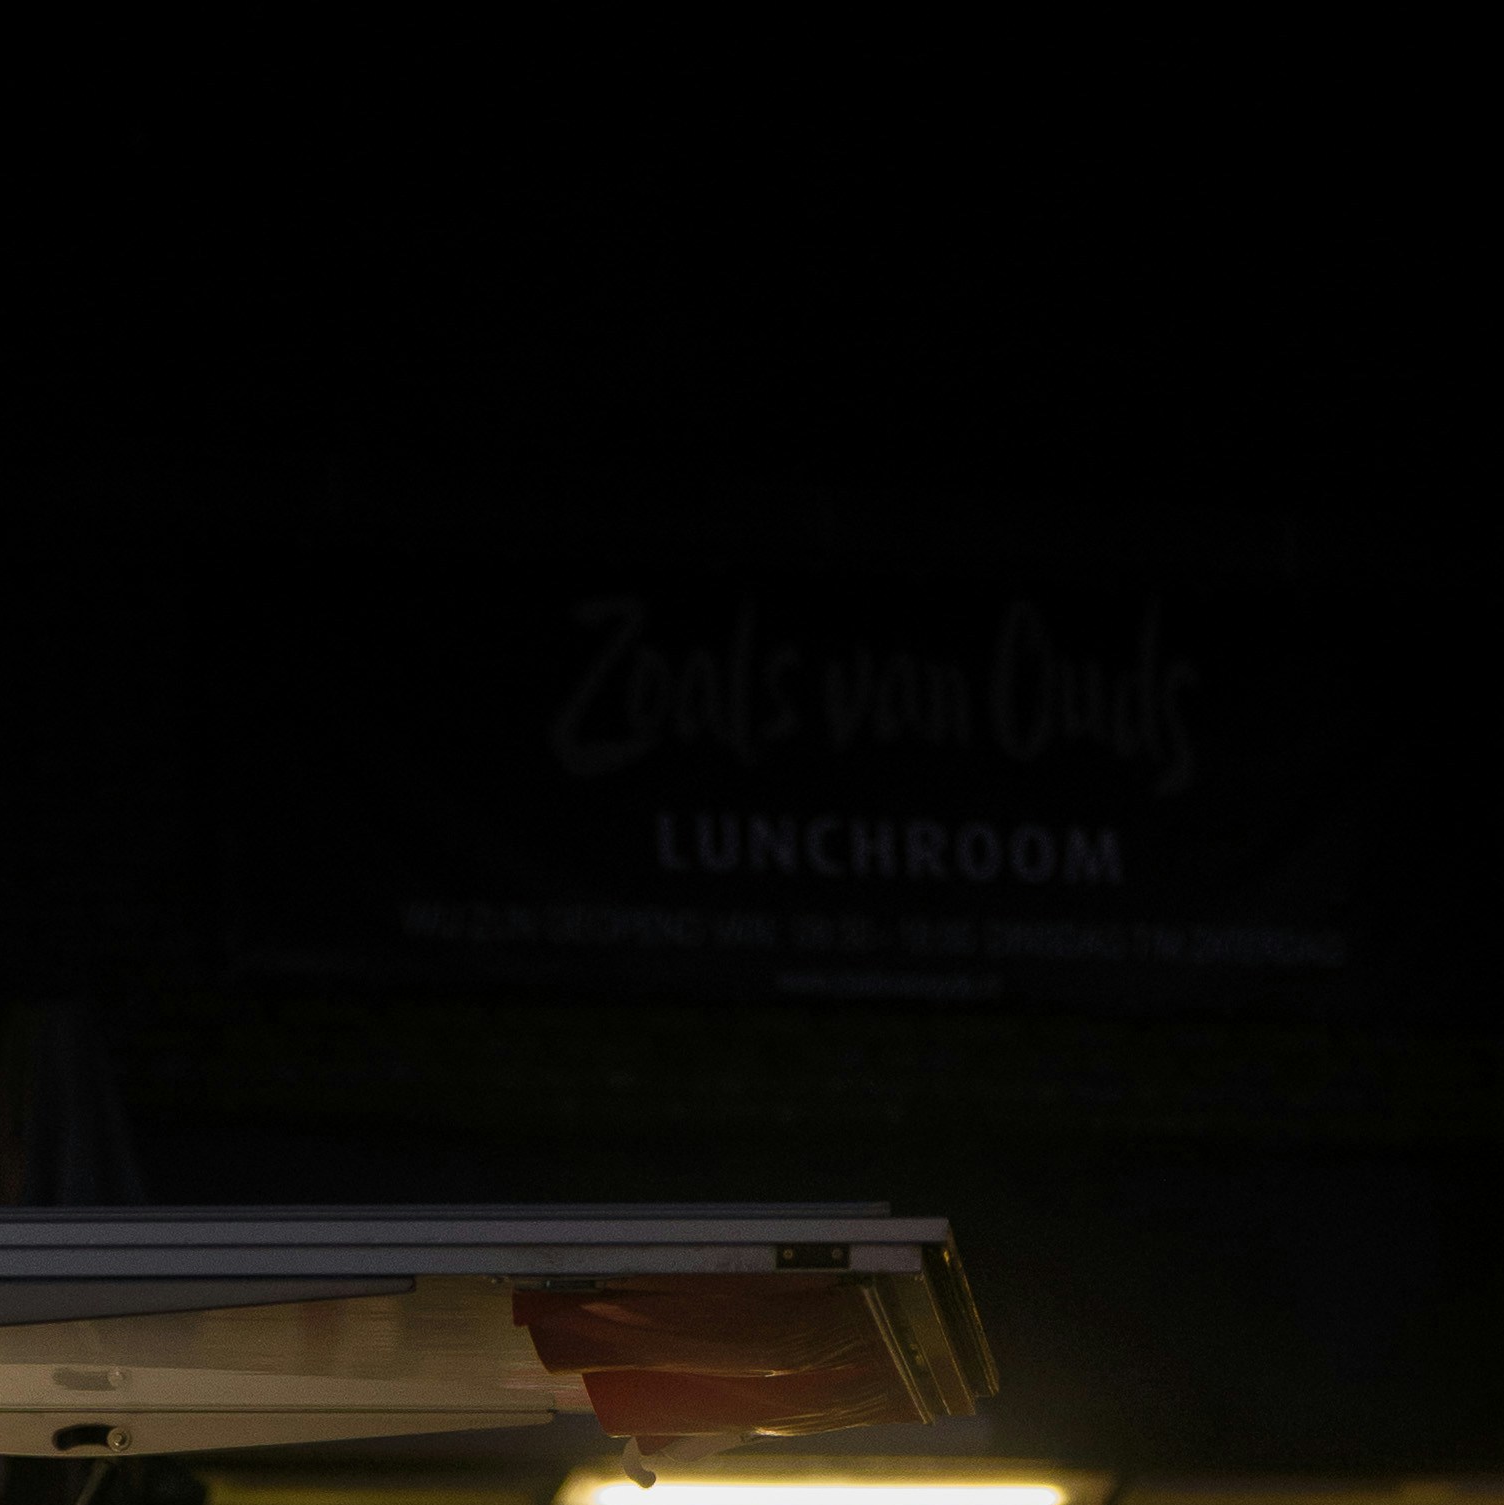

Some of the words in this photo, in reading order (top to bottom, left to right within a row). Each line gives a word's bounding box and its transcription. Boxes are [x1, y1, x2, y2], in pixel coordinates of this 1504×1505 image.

[547, 592, 803, 778] Zoals
[822, 636, 974, 752] van
[987, 594, 1200, 798] Ouds
[655, 808, 1126, 887] LUNCHROOM
